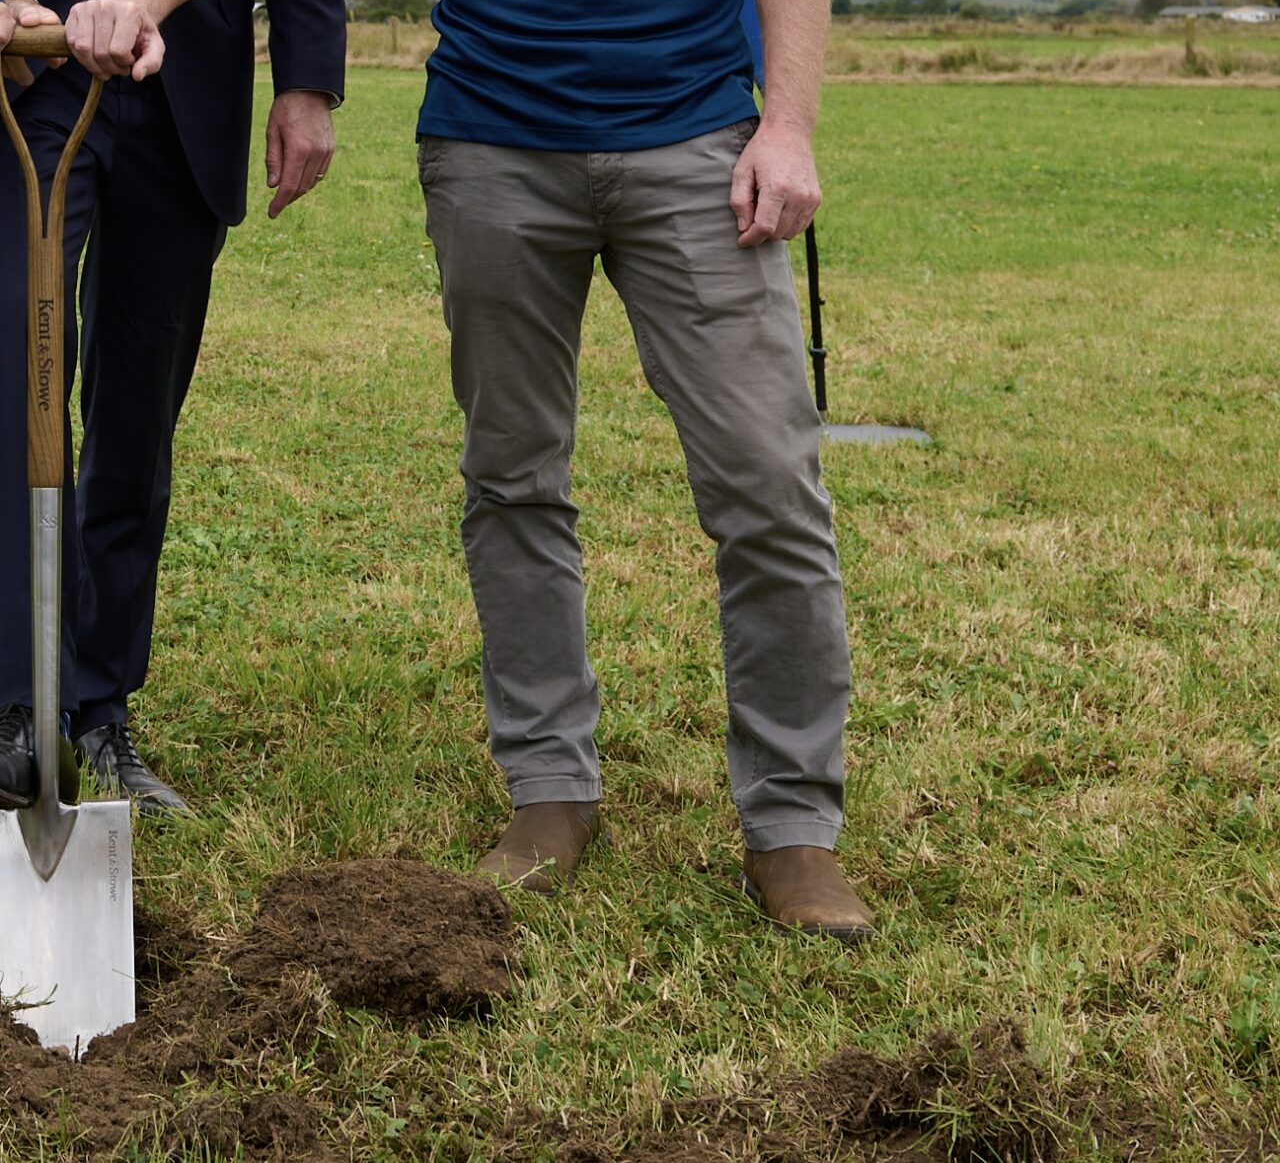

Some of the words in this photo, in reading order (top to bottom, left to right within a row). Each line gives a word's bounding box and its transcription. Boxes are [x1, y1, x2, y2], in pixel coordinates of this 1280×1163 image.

[38, 299, 54, 341] Kent
[38, 344, 49, 357] &
[38, 357, 54, 412] Stowe
[108, 830, 118, 857] Kent
[109, 867, 119, 902] Stowe
